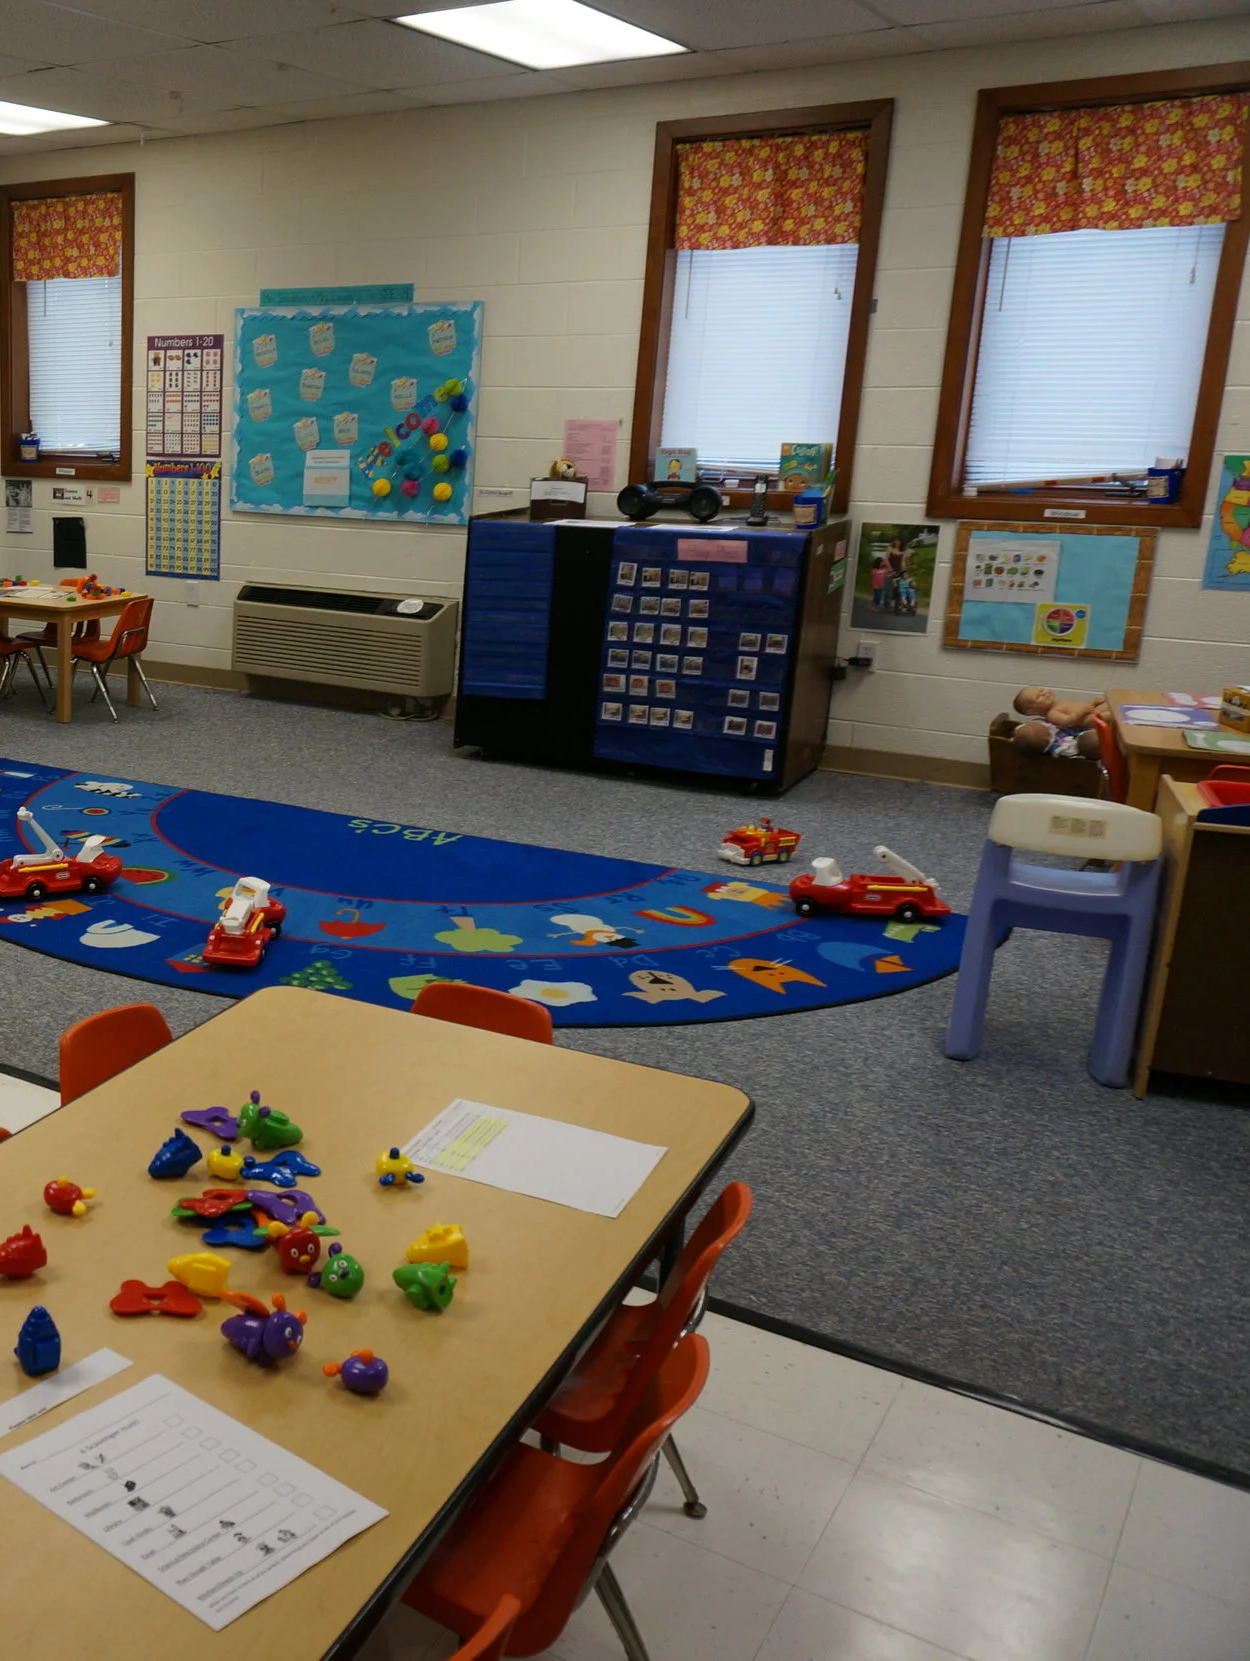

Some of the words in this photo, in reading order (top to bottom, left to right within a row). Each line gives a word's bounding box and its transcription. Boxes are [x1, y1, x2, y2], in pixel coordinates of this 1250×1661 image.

[154, 338, 193, 347] Numbers
[196, 336, 214, 347] 1-20
[357, 394, 440, 480] Welcom
[153, 462, 189, 474] Numbers
[87, 490, 92, 499] 4
[347, 818, 463, 847] ABC's
